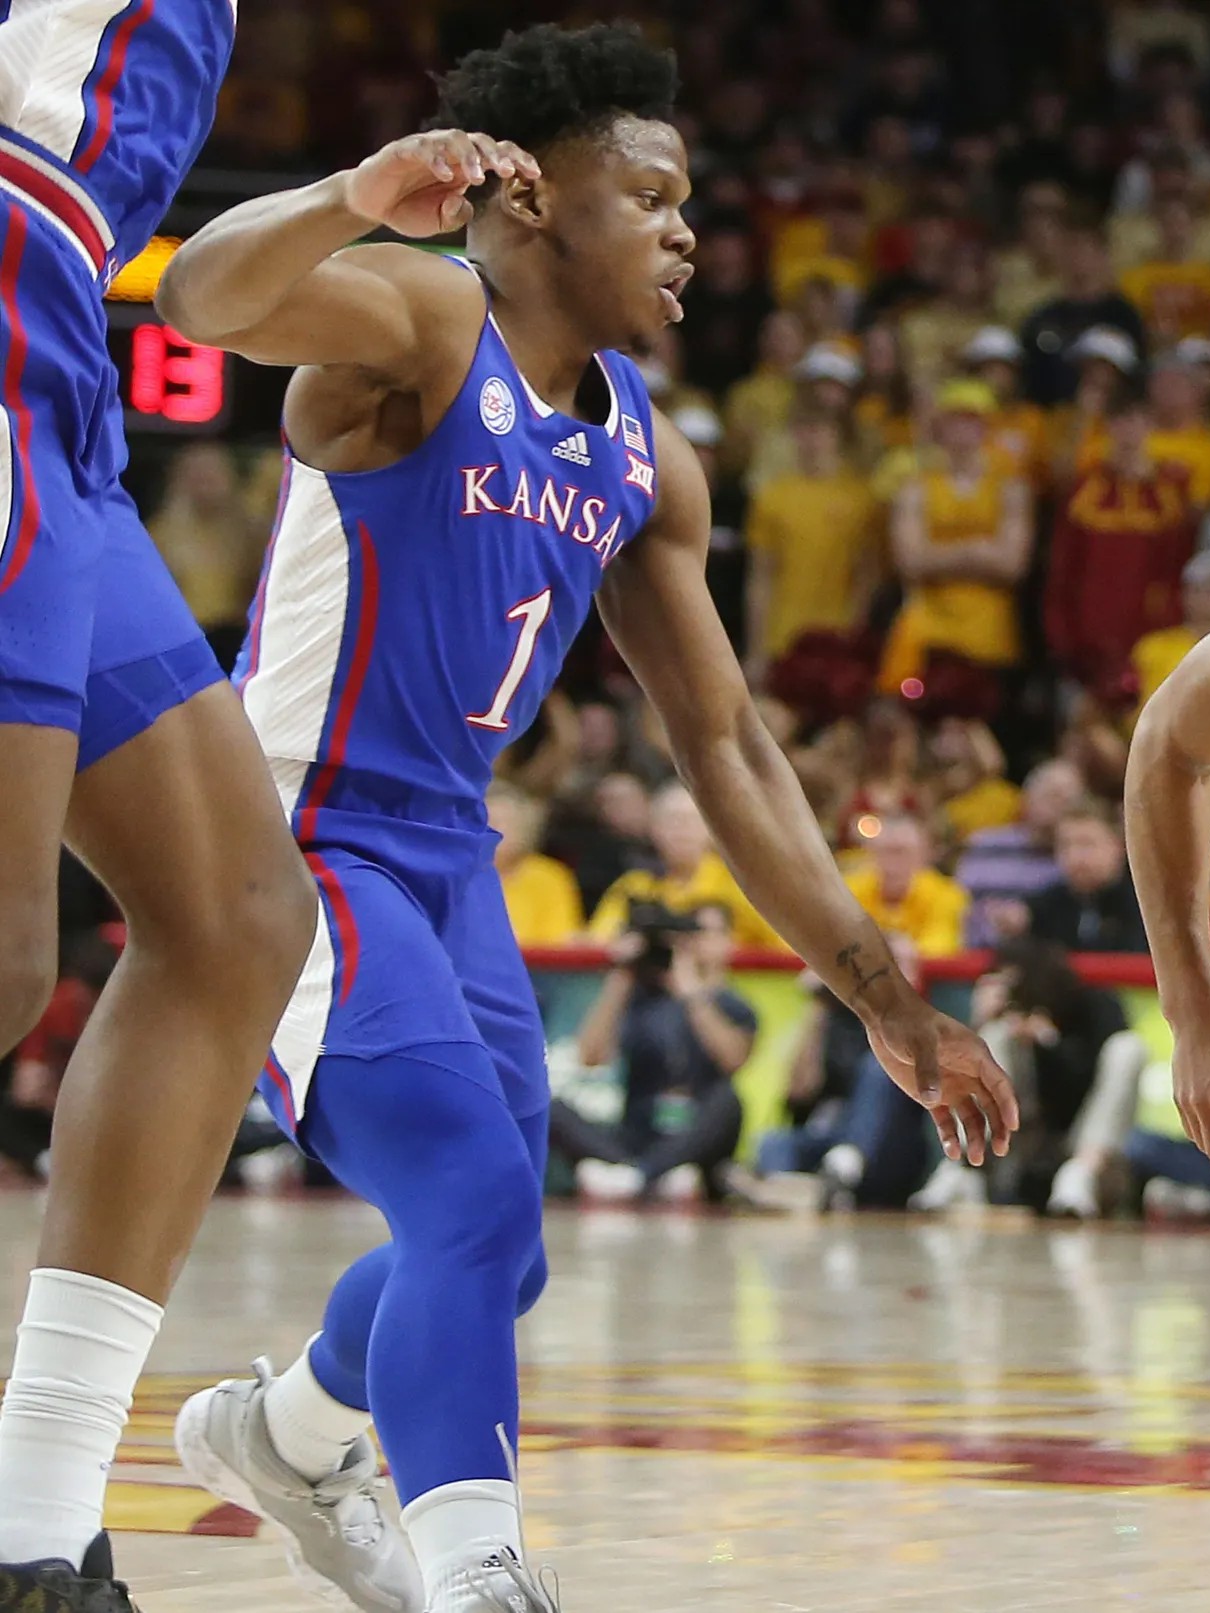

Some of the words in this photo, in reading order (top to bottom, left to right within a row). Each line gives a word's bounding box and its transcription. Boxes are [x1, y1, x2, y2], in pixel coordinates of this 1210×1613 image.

[551, 446, 592, 467] adidas
[460, 463, 625, 568] KANSA
[464, 586, 552, 733] 1
